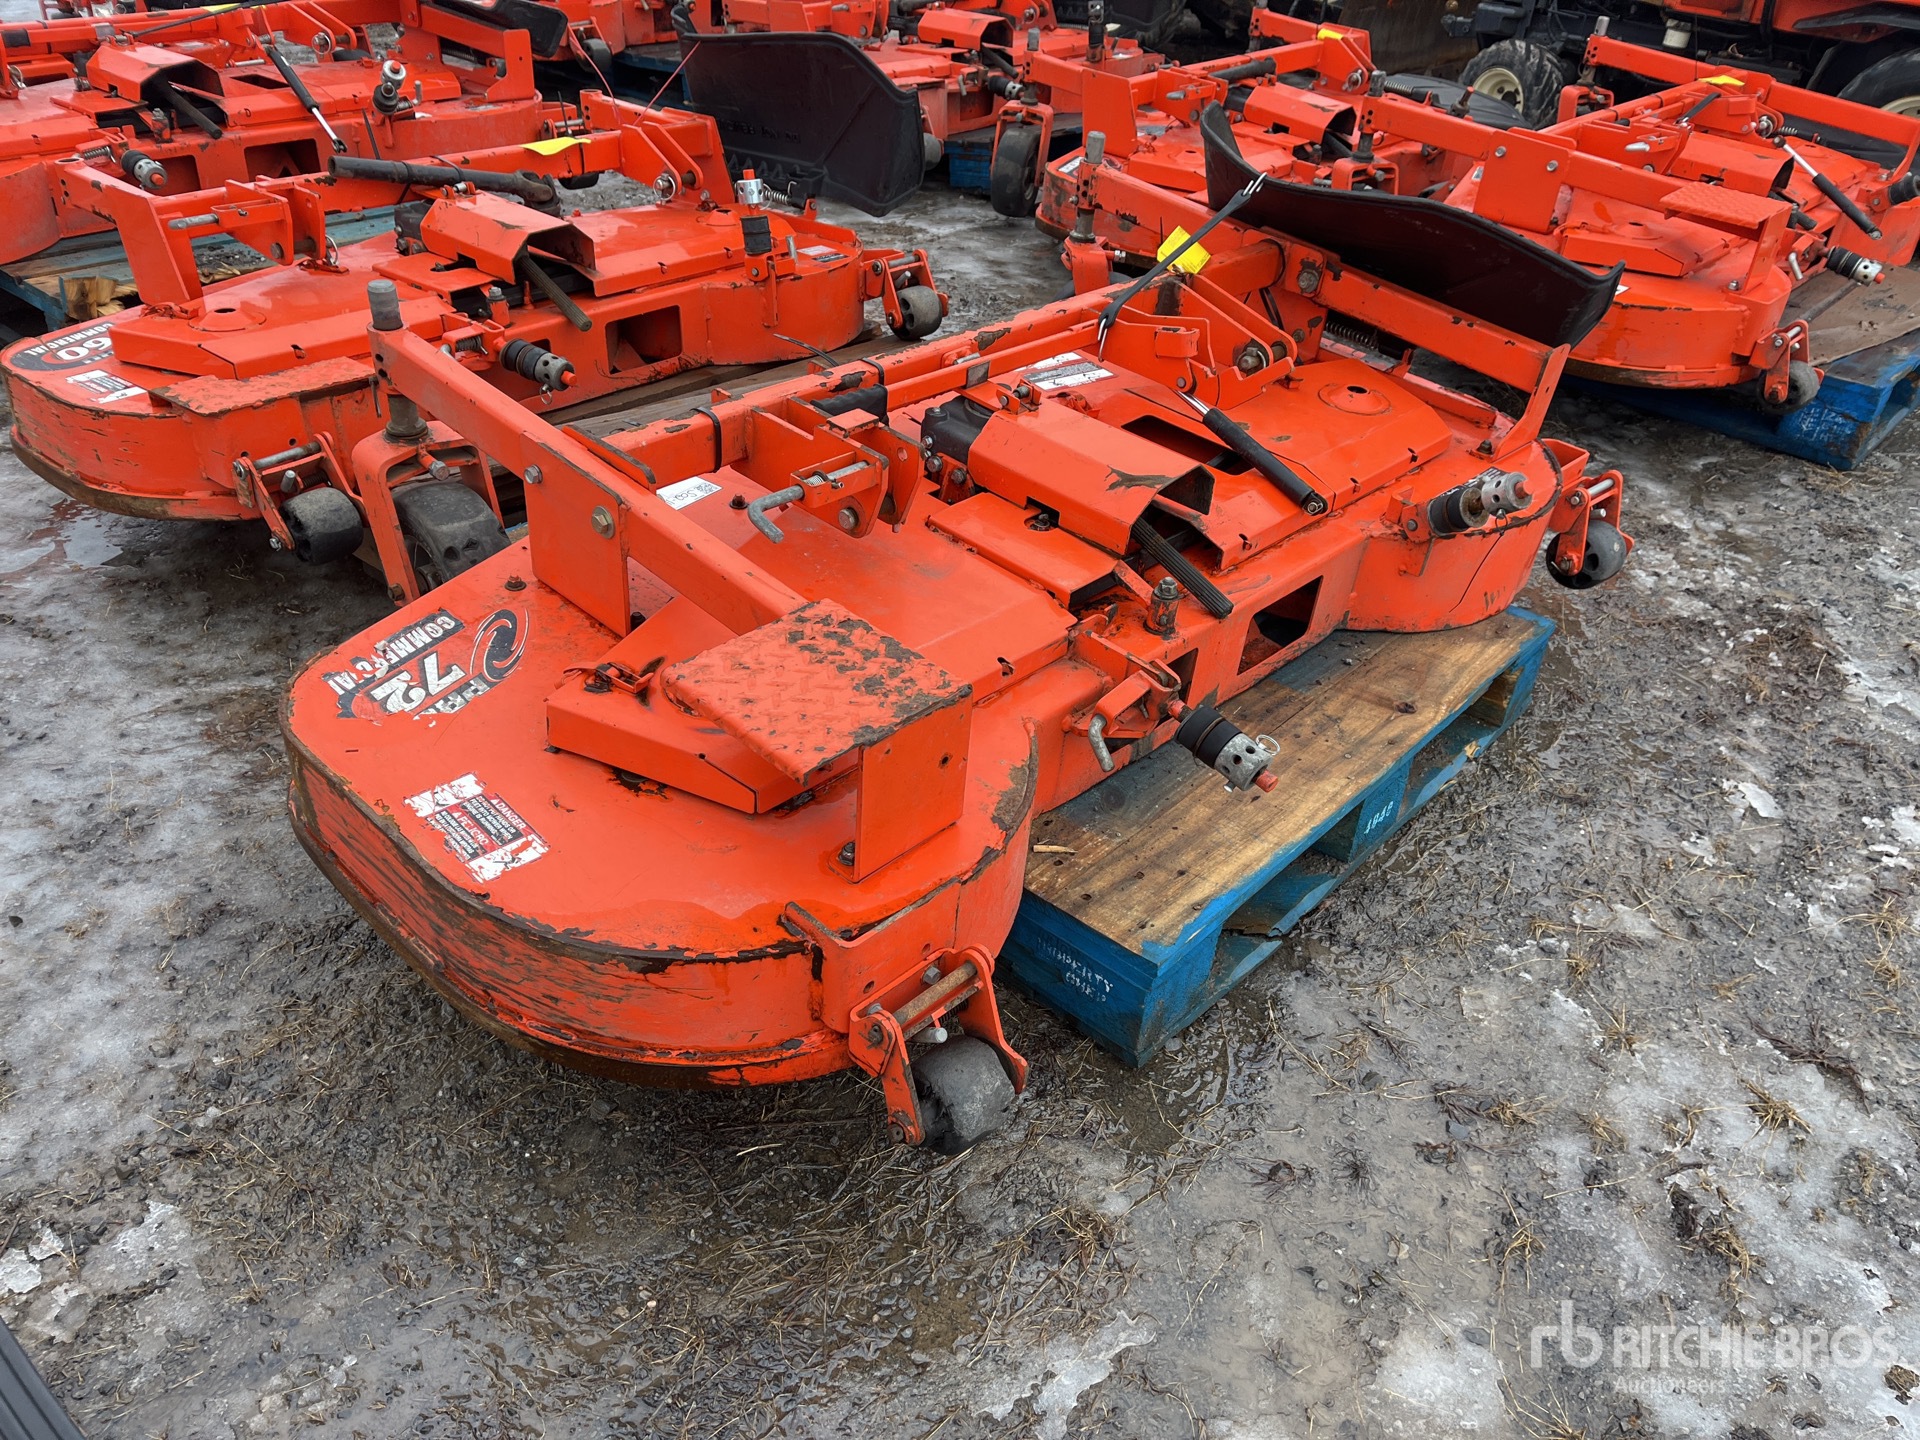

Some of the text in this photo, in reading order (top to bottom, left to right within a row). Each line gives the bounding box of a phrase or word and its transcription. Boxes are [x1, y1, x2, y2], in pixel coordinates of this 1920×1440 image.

[56, 337, 112, 360] 60
[369, 651, 467, 714] 72
[494, 801, 527, 830] DANGER
